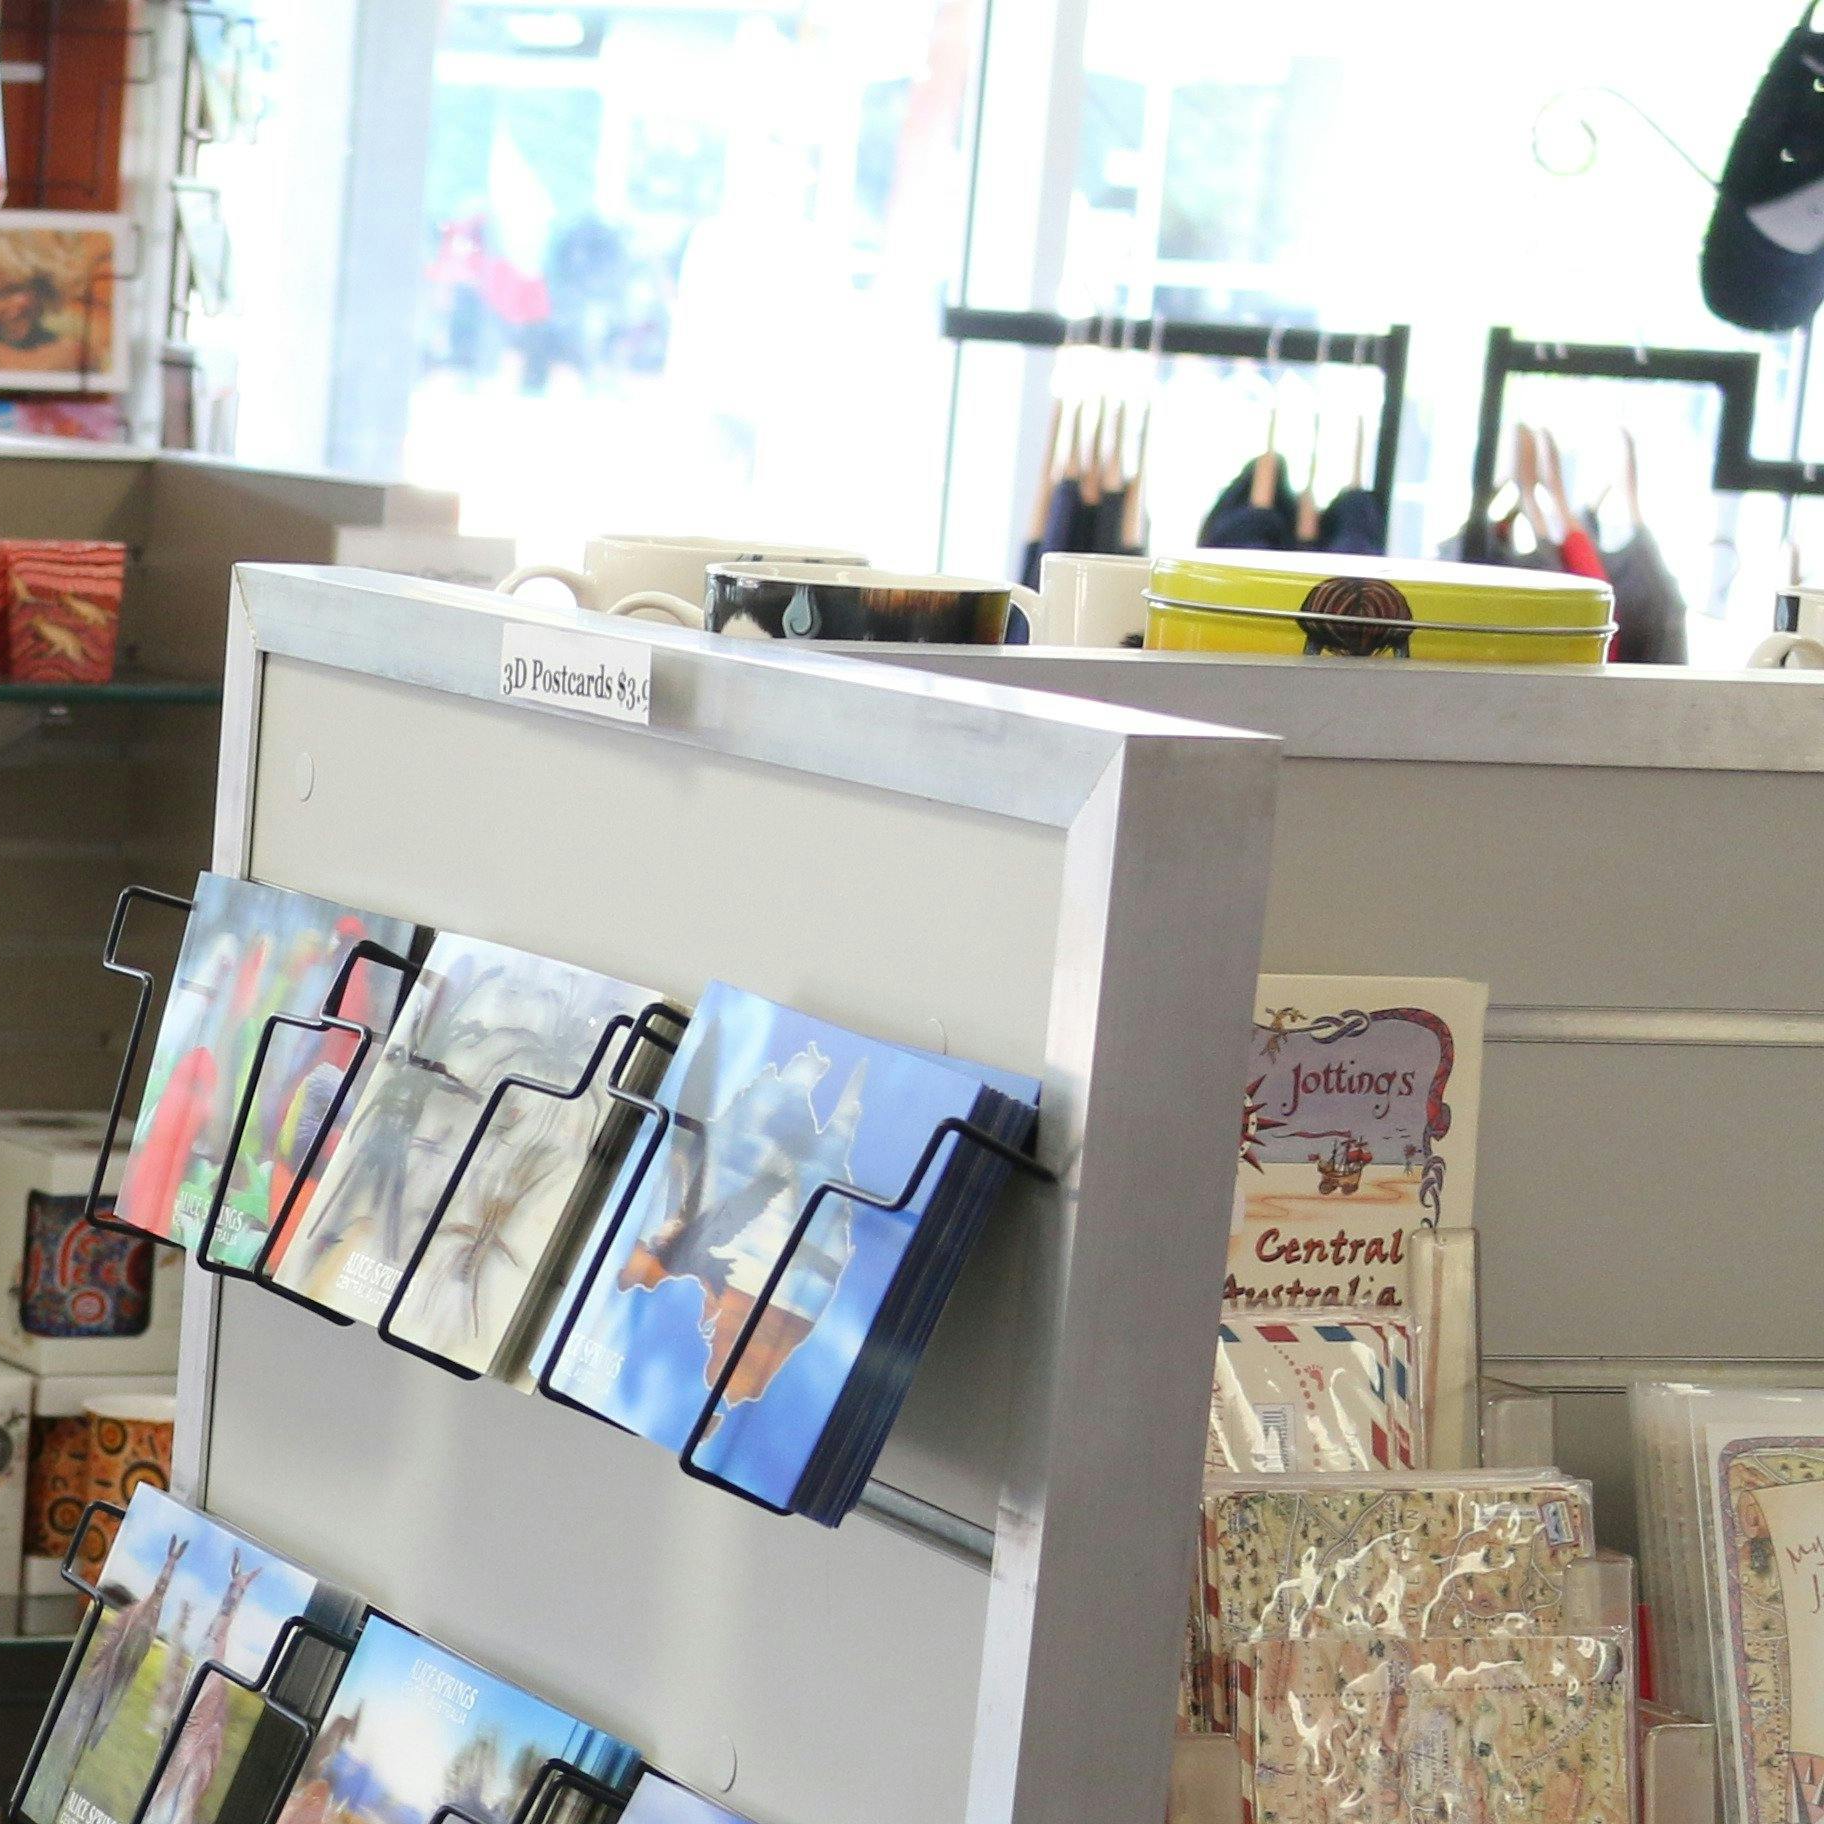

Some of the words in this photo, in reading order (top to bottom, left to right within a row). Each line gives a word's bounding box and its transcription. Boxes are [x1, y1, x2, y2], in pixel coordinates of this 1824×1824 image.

[503, 656, 528, 696] 3D
[531, 658, 613, 700] Postcards
[1281, 1060, 1416, 1120] Jottings
[1255, 1227, 1405, 1266] Central
